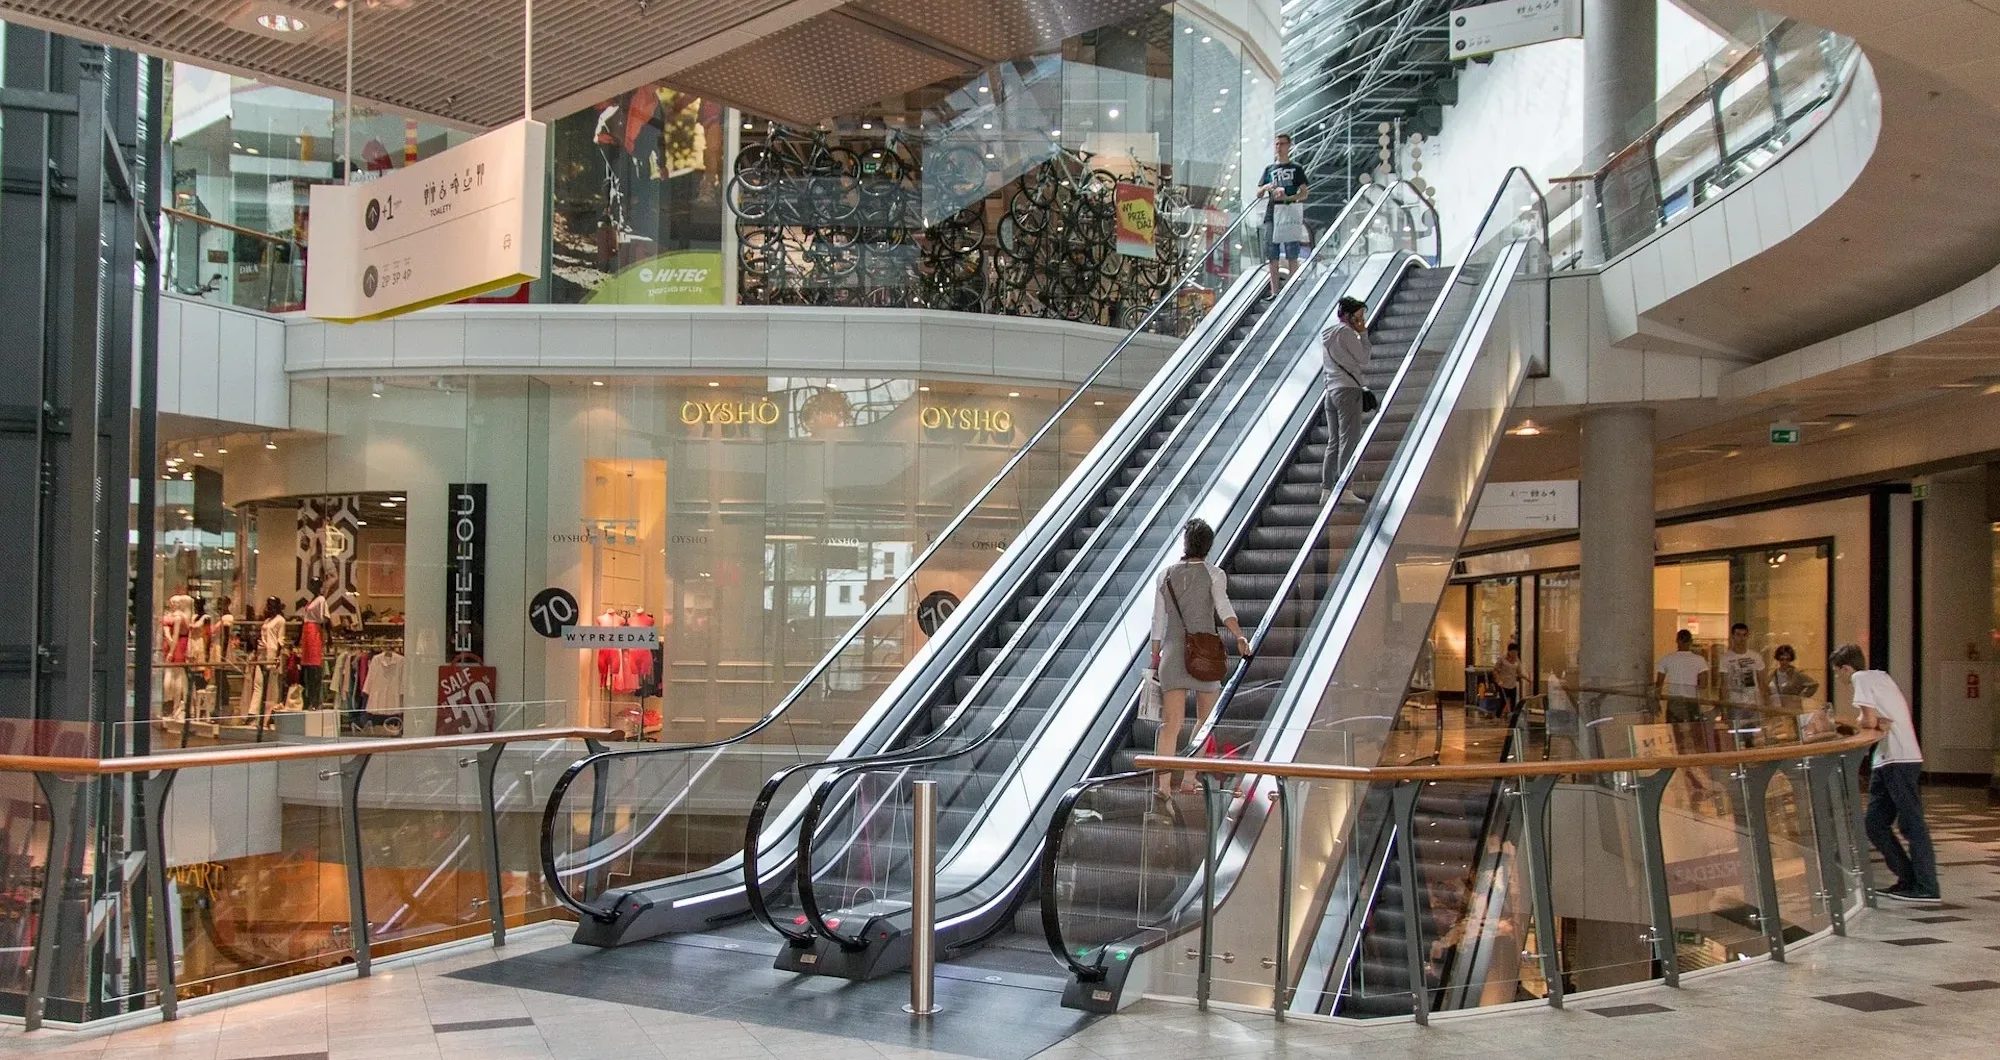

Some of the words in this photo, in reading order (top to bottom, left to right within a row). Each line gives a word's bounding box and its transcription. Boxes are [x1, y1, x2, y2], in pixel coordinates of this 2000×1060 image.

[429, 204, 452, 218] TOALETY
[654, 268, 708, 283] HI-TEC
[680, 400, 780, 425] OYSHO
[920, 406, 1012, 433] OYSHO
[552, 534, 589, 543] OYSHO
[671, 535, 708, 544] OYSHO
[566, 632, 656, 642] WYPRZEDAŻ
[440, 667, 474, 695] SALE
